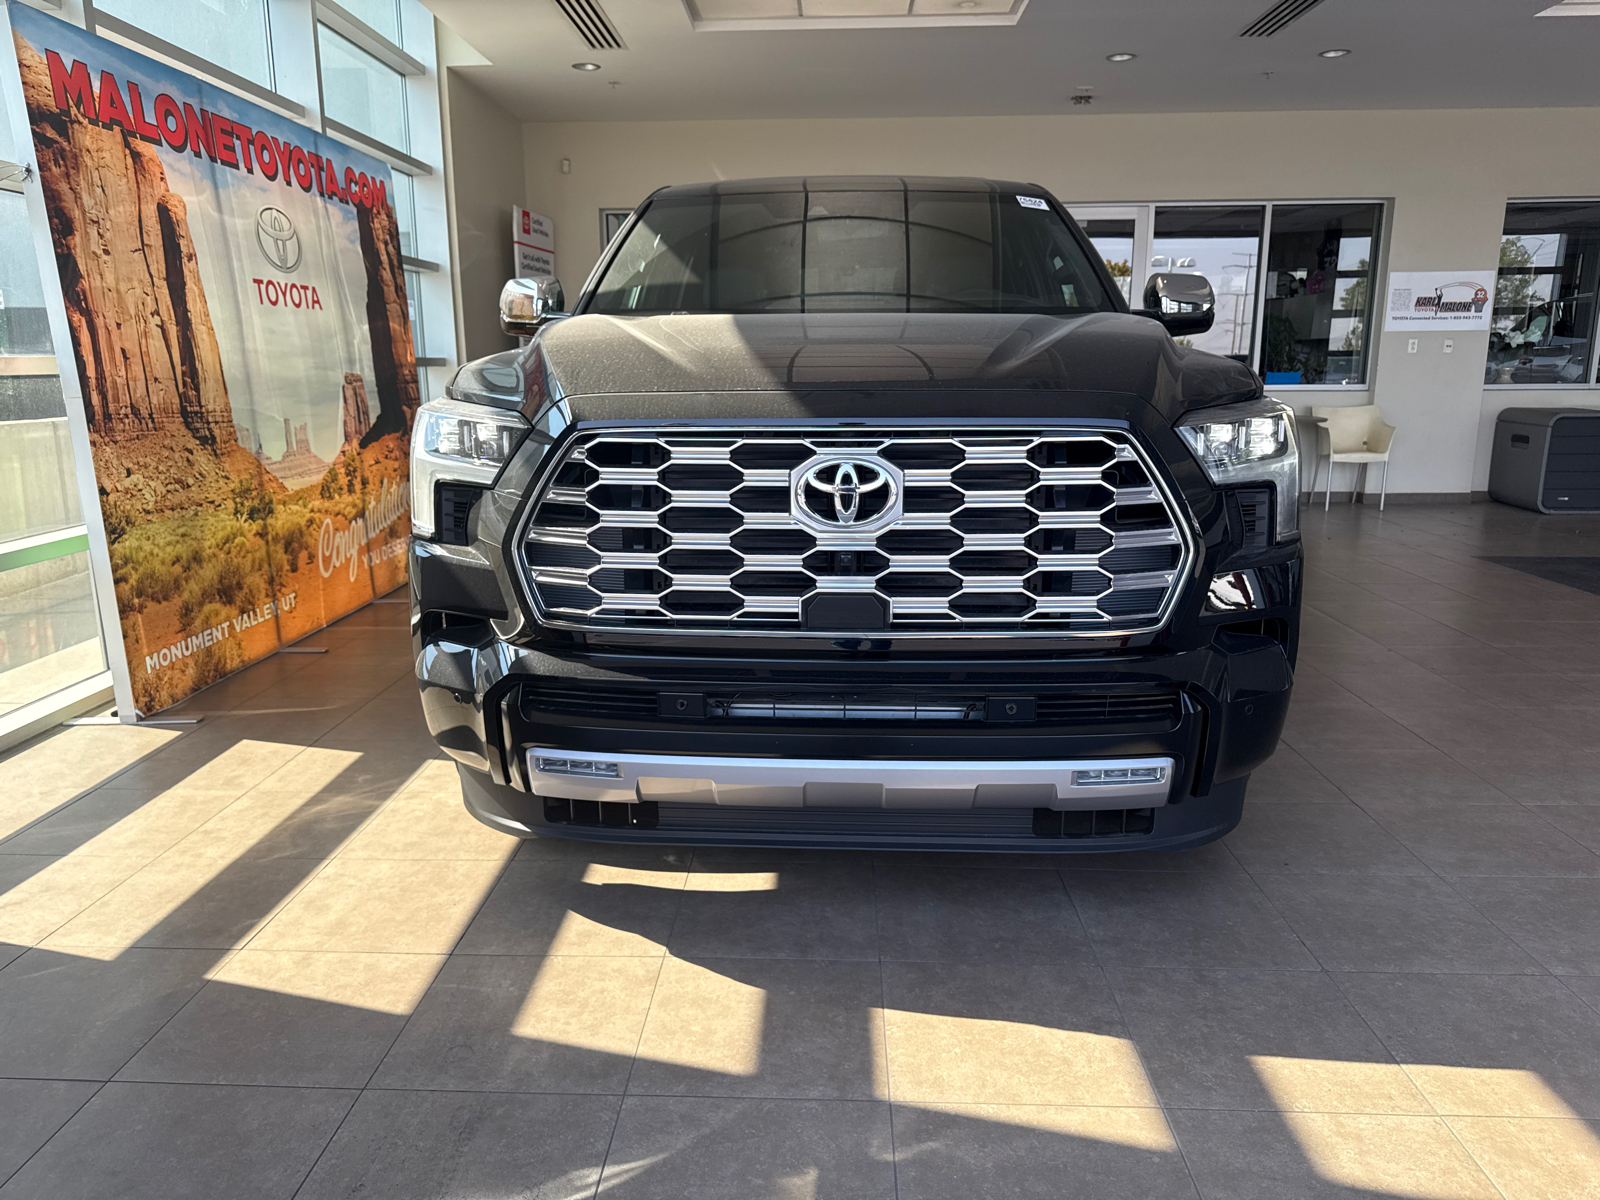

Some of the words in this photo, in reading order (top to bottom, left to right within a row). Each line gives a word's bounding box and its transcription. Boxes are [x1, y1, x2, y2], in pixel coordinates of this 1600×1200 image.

[45, 48, 389, 212] MALONETOYOTA.COM
[253, 278, 323, 311] TOYOTA
[1415, 297, 1437, 307] KARL
[1440, 302, 1473, 312] MALONE
[362, 549, 381, 569] YOU
[145, 622, 230, 674] MONUMENT
[281, 592, 297, 609] UT
